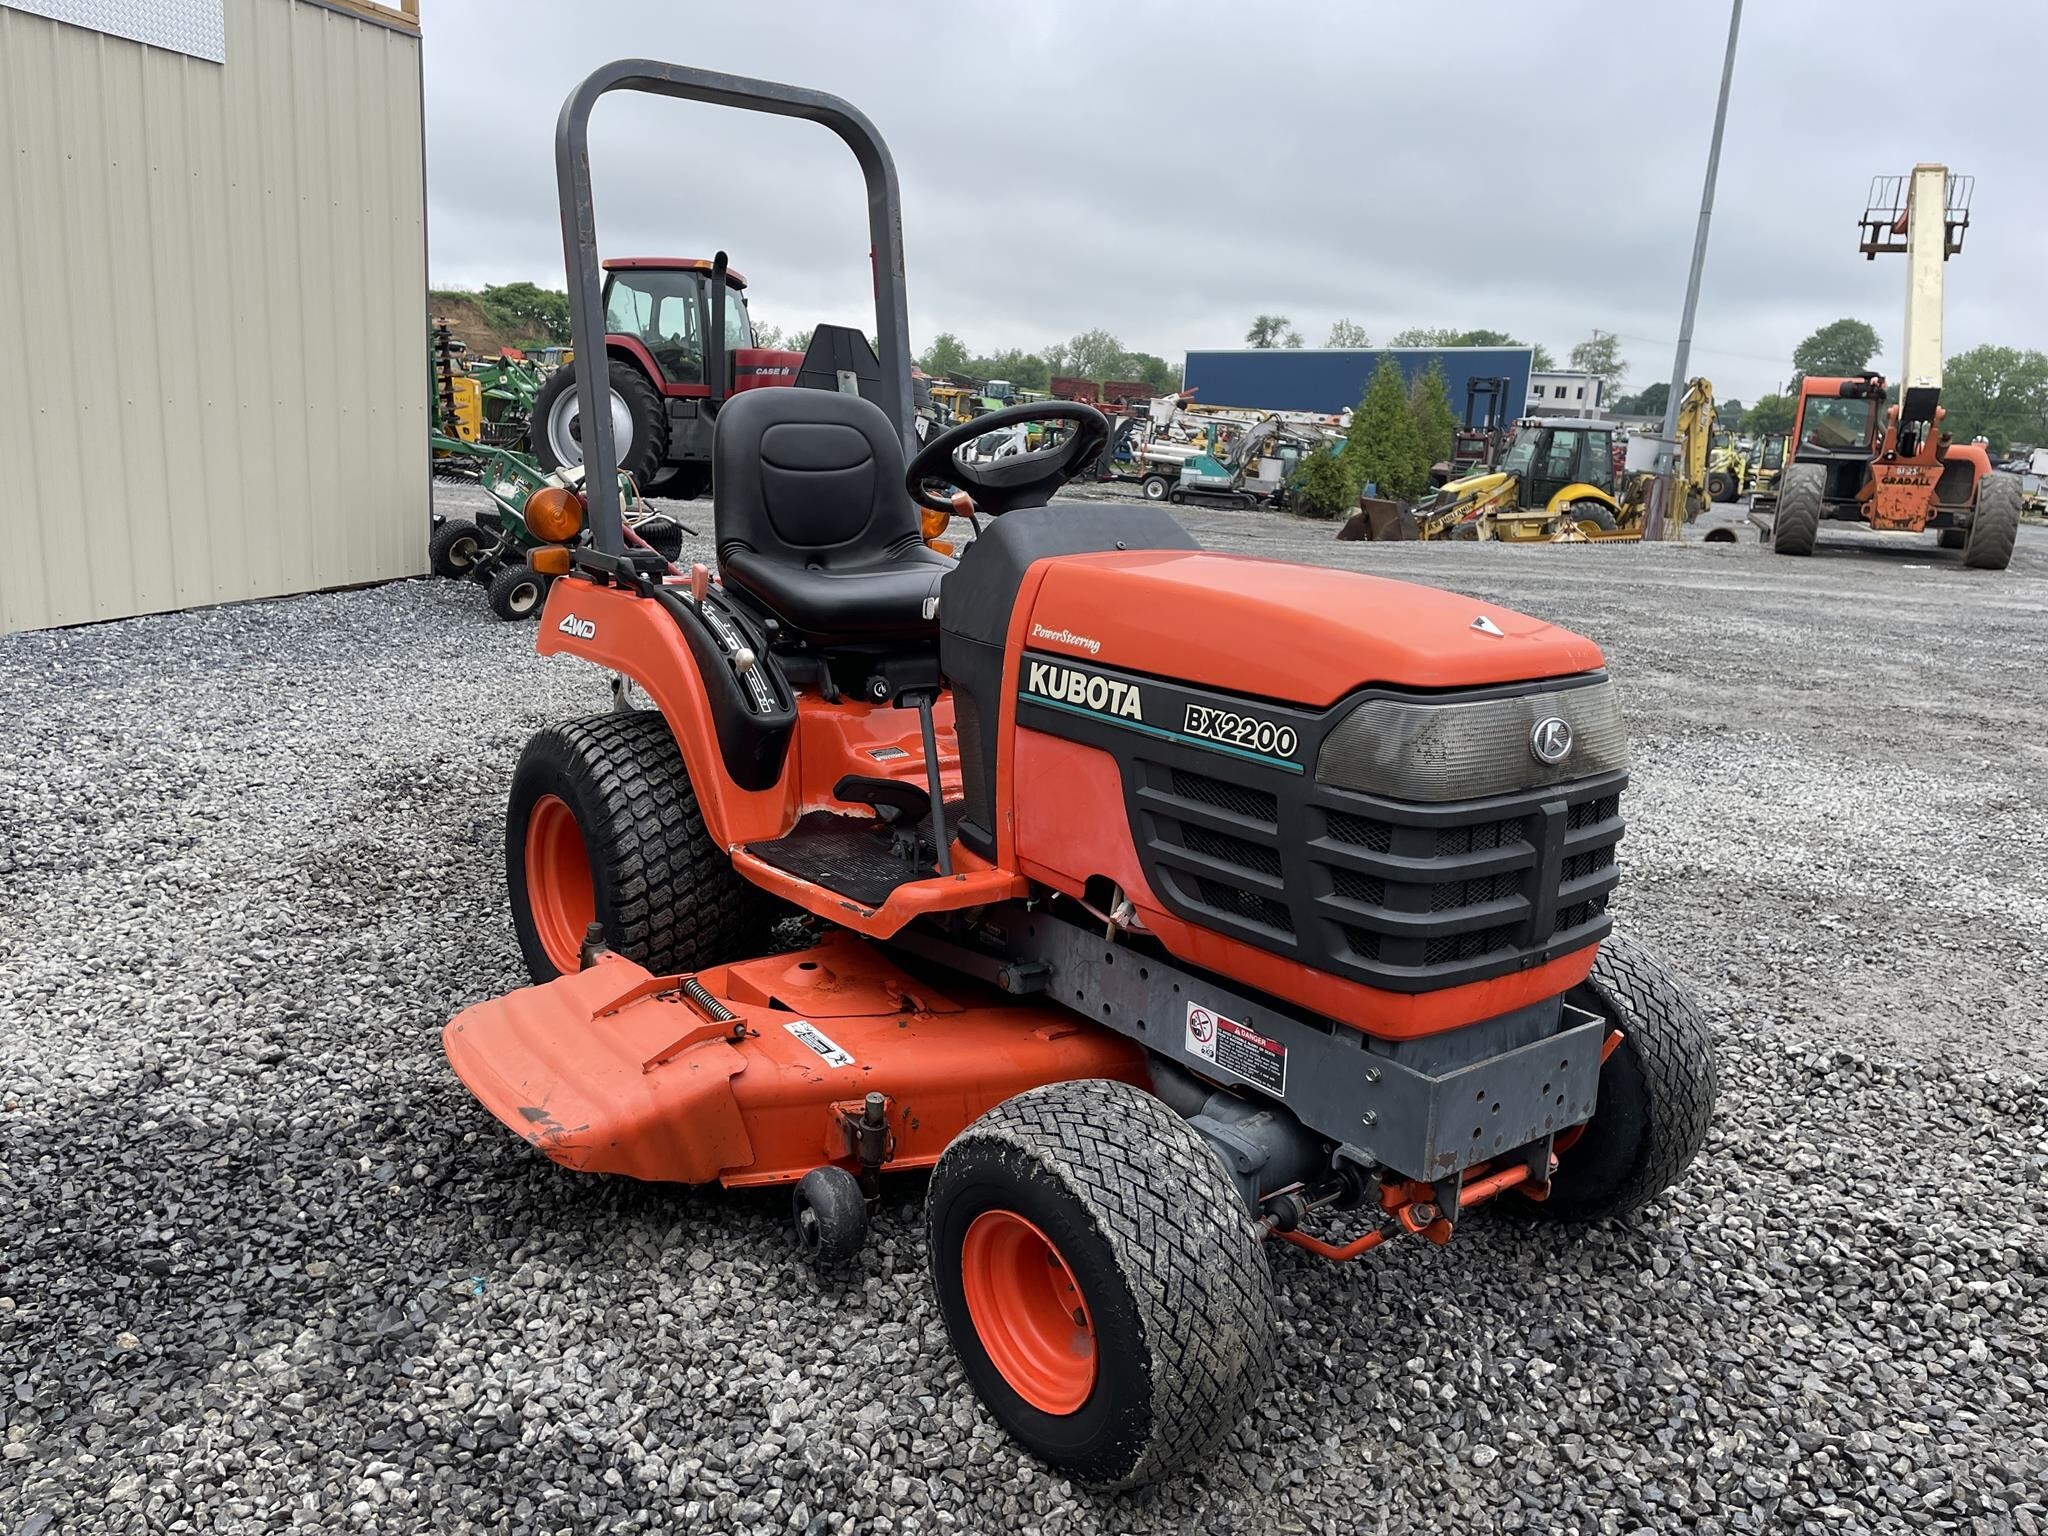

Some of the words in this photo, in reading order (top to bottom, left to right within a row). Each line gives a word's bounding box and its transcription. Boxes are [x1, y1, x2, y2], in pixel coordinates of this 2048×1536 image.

[755, 367, 780, 375] CASE
[1882, 477, 1931, 486] GRADALL
[558, 613, 596, 640] 4WD
[1028, 661, 1143, 721] KUBOTA
[1184, 703, 1298, 758] BX2200
[1241, 1030, 1267, 1046] DANGER
